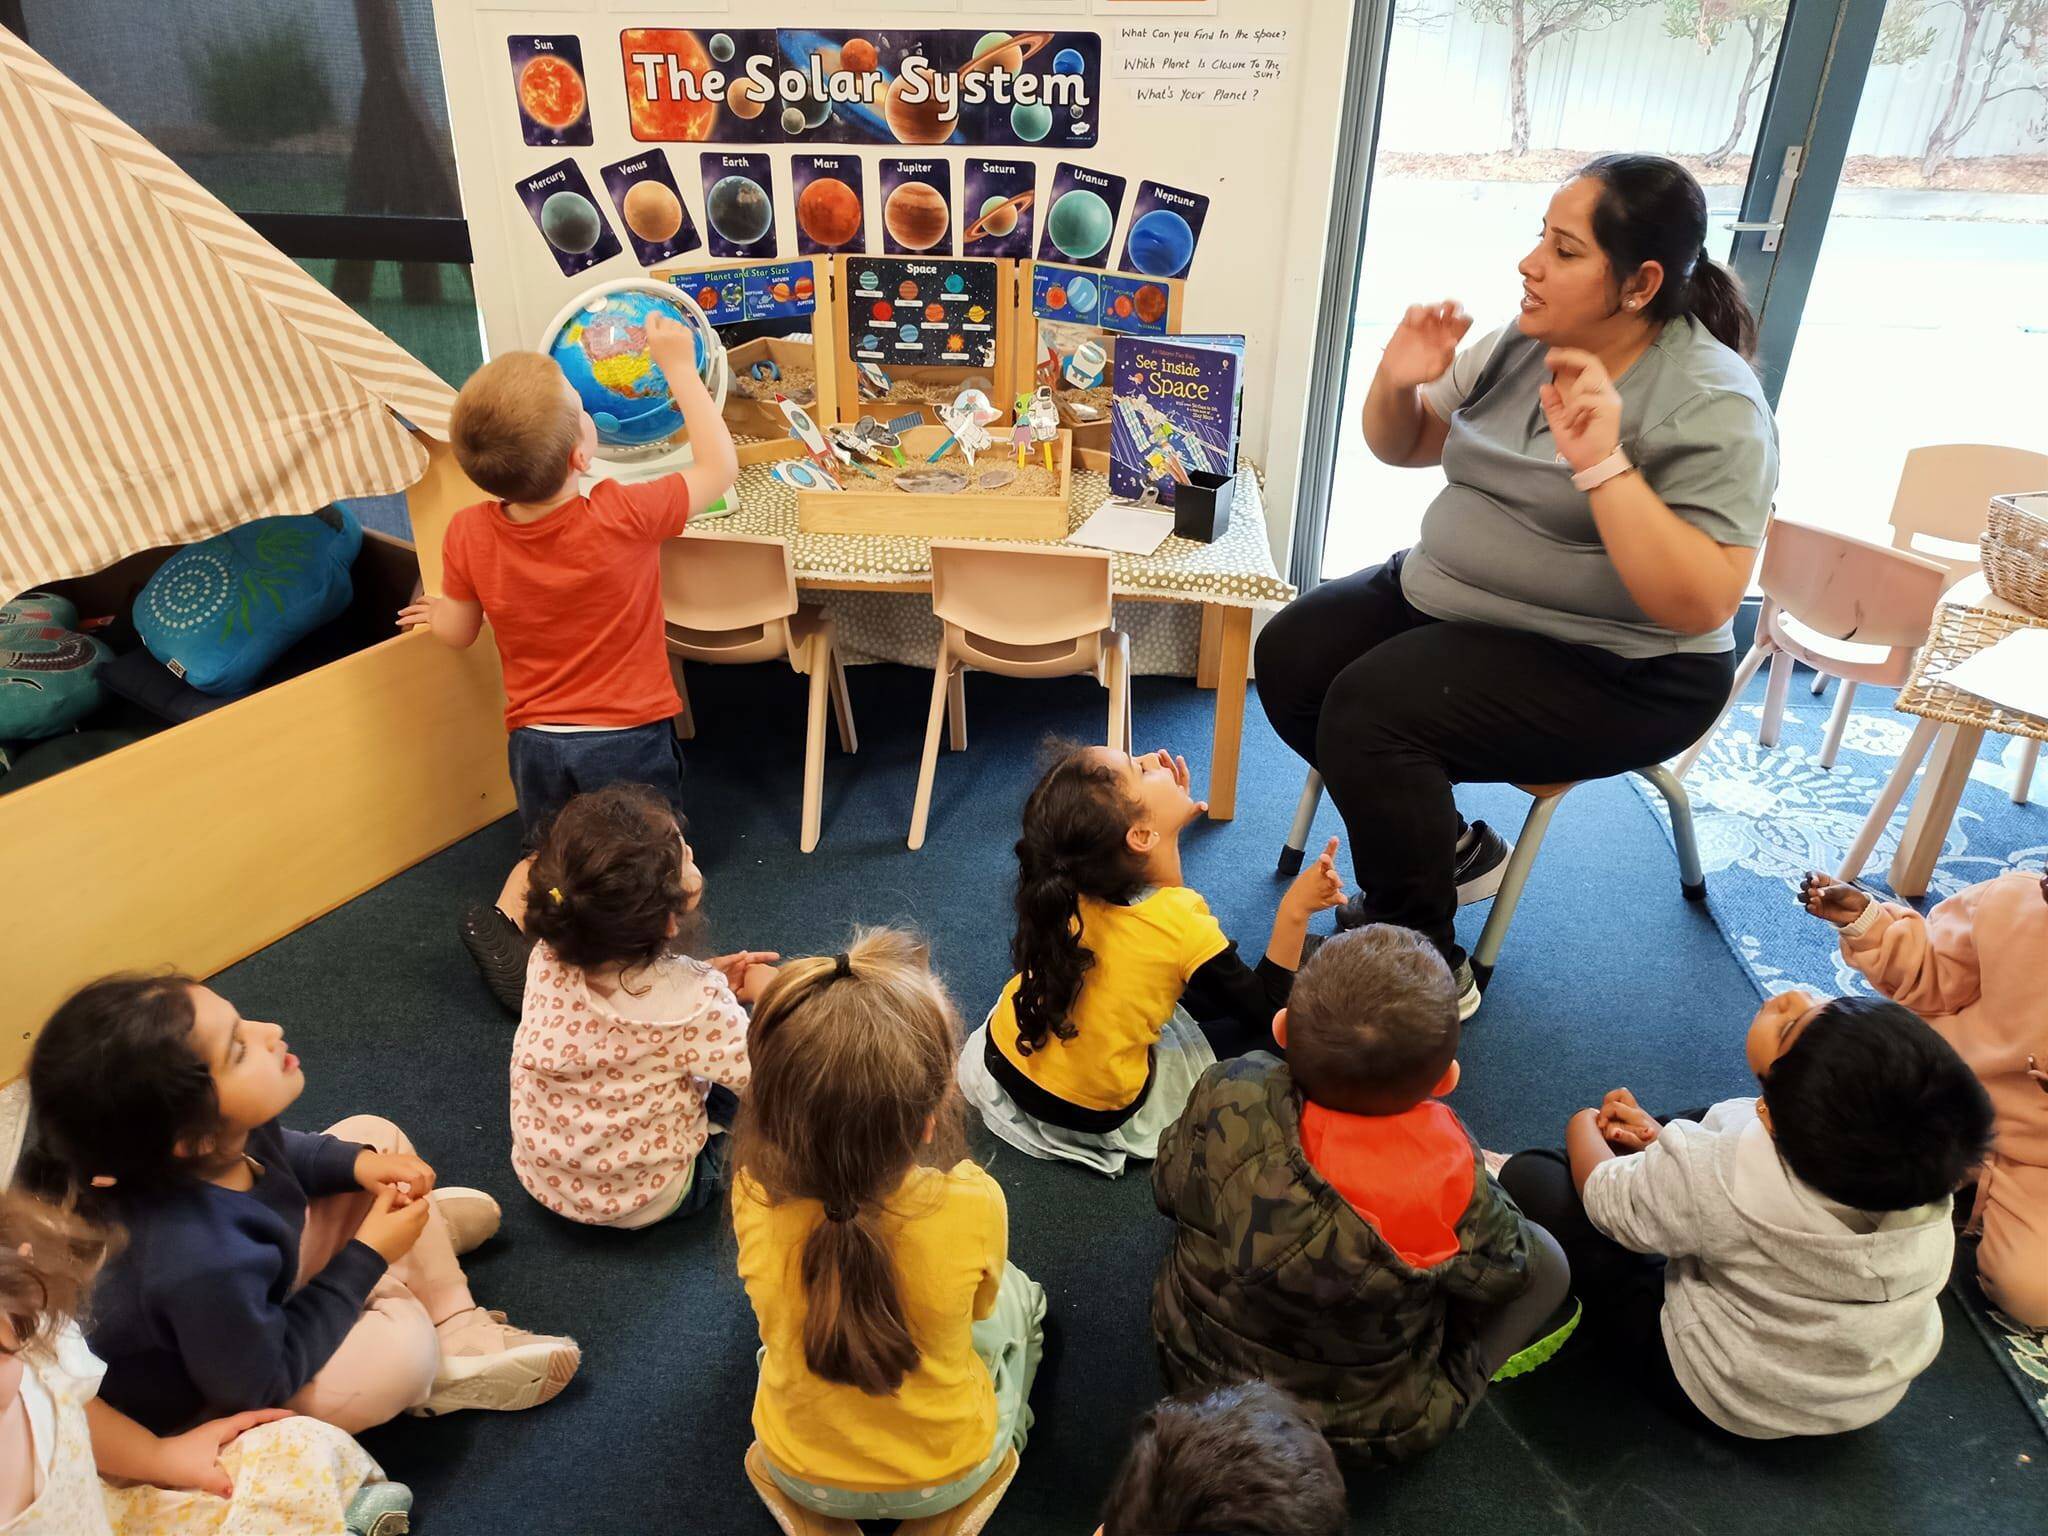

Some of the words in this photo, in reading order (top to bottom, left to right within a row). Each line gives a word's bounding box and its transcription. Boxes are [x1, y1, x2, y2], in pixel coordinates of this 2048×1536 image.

[1122, 28, 1147, 38] What
[1152, 28, 1170, 39] Can
[534, 39, 554, 50] Sun
[1124, 57, 1156, 71] Which
[1162, 58, 1191, 70] Planet
[631, 52, 726, 102] The
[744, 53, 883, 103] Solar
[899, 55, 1090, 121] System
[1137, 85, 1174, 100] What's
[618, 160, 648, 176] Venus
[722, 156, 749, 167] Earth
[813, 158, 839, 169] Mars
[897, 162, 933, 175] Jupiter
[982, 162, 1016, 174] Saturn
[528, 170, 566, 192] Mercury
[1074, 169, 1108, 187] Uranus
[1154, 187, 1196, 208] Neptune
[704, 272, 731, 281] Planet
[734, 269, 749, 279] and
[751, 268, 768, 277] Star
[771, 266, 790, 275] Sizes
[906, 263, 937, 276] Space
[1136, 354, 1157, 370] See
[1162, 358, 1200, 377] inside
[1148, 372, 1210, 400] Space
